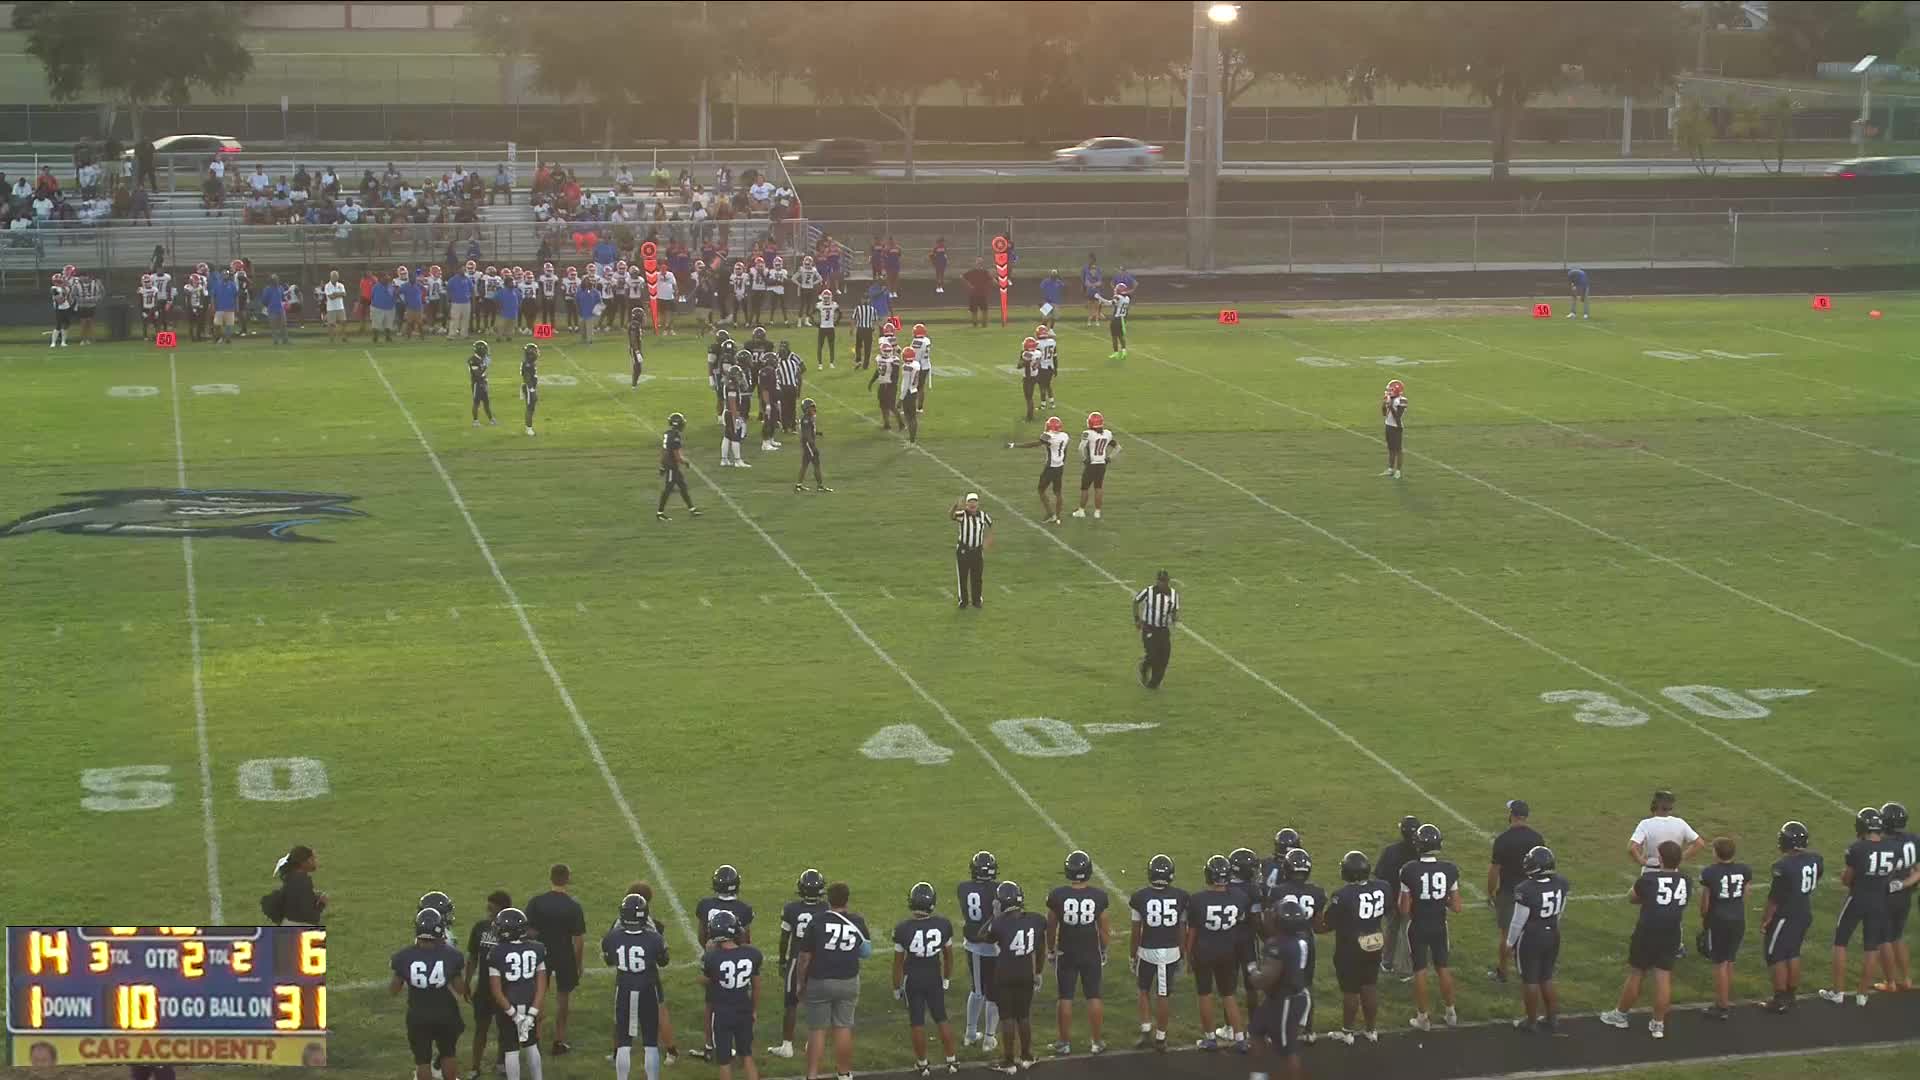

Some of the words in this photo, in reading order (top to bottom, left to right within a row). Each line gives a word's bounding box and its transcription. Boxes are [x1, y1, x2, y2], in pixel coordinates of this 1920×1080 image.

[1224, 311, 1236, 322] 20
[157, 334, 172, 346] 50
[537, 326, 550, 337] 40
[1095, 438, 1107, 457] 10
[1868, 851, 1895, 875] 15
[1420, 871, 1446, 900] 19
[1657, 877, 1688, 906] 54
[1719, 873, 1744, 899] 17
[1801, 866, 1817, 892] 61
[967, 892, 981, 921] 8
[1063, 898, 1096, 926] 88
[1146, 898, 1177, 927] 85
[1204, 904, 1238, 931] 53
[1358, 889, 1384, 920] 62
[824, 923, 857, 951] 75
[909, 928, 942, 957] 42
[1009, 927, 1035, 956] 41
[504, 950, 538, 982] 30
[615, 945, 646, 973] 16
[410, 960, 446, 989] 64
[719, 959, 753, 989] 32
